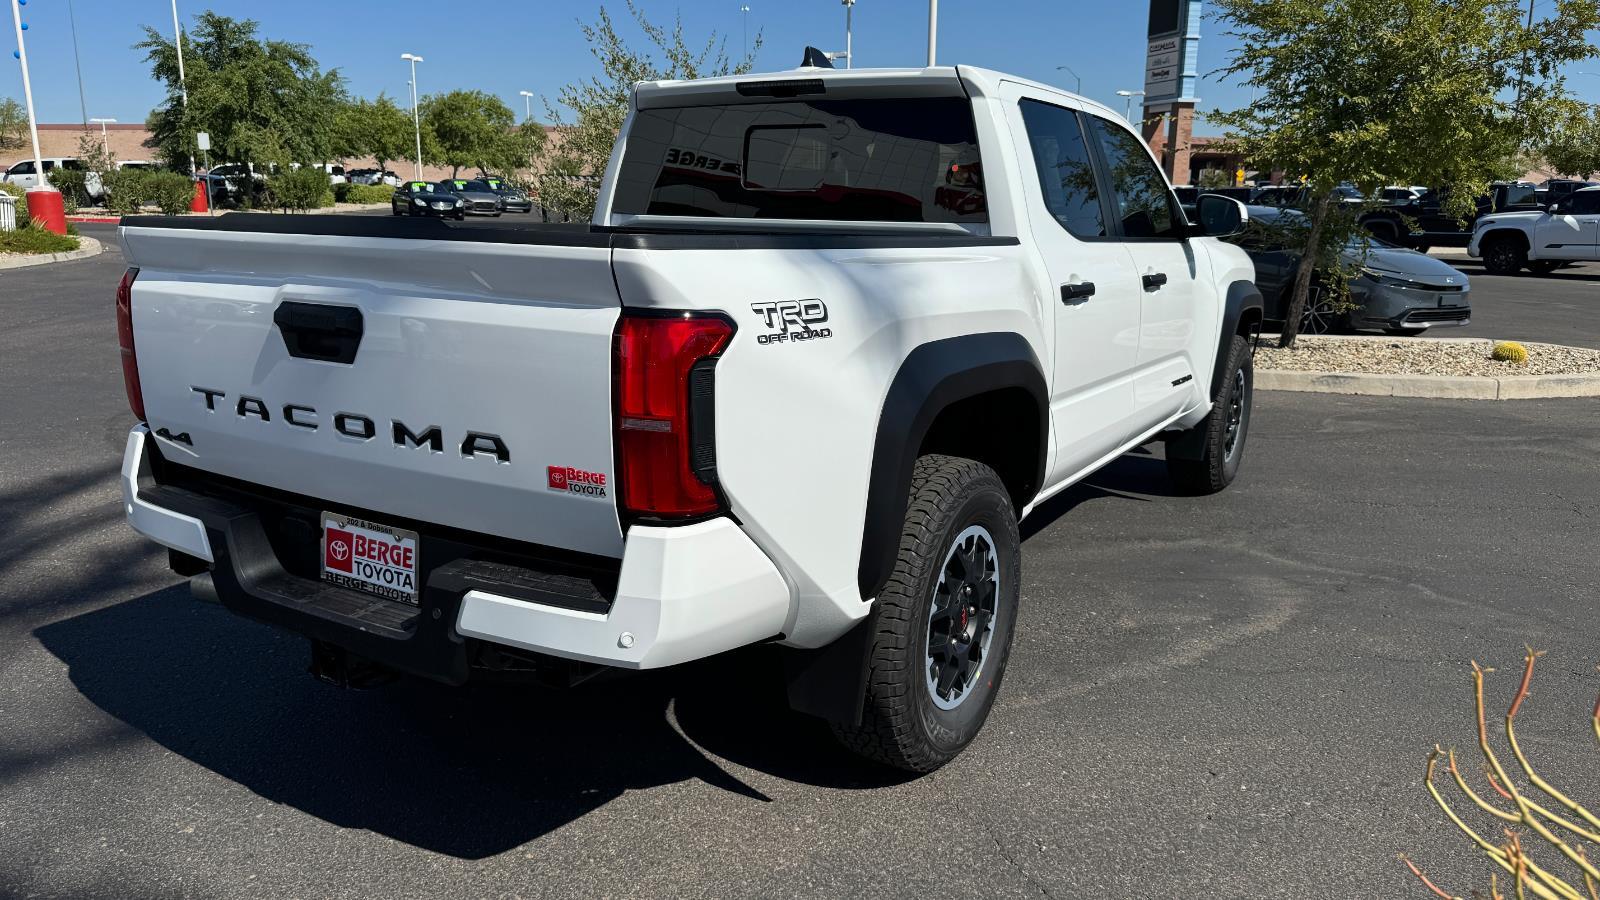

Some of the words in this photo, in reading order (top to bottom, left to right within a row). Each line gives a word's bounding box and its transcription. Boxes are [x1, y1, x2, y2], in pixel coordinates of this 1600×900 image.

[751, 298, 828, 333] TRD
[757, 333, 788, 345] OFF
[790, 328, 832, 342] ROAD
[189, 385, 511, 465] TACOMA
[566, 467, 606, 485] BERGE
[568, 483, 607, 497] TOYOTA
[346, 518, 359, 527] 202
[355, 534, 413, 569] BERGE
[326, 571, 369, 592] BERGE
[370, 583, 413, 603] TOYOTA
[354, 561, 413, 590] TOYOTA
